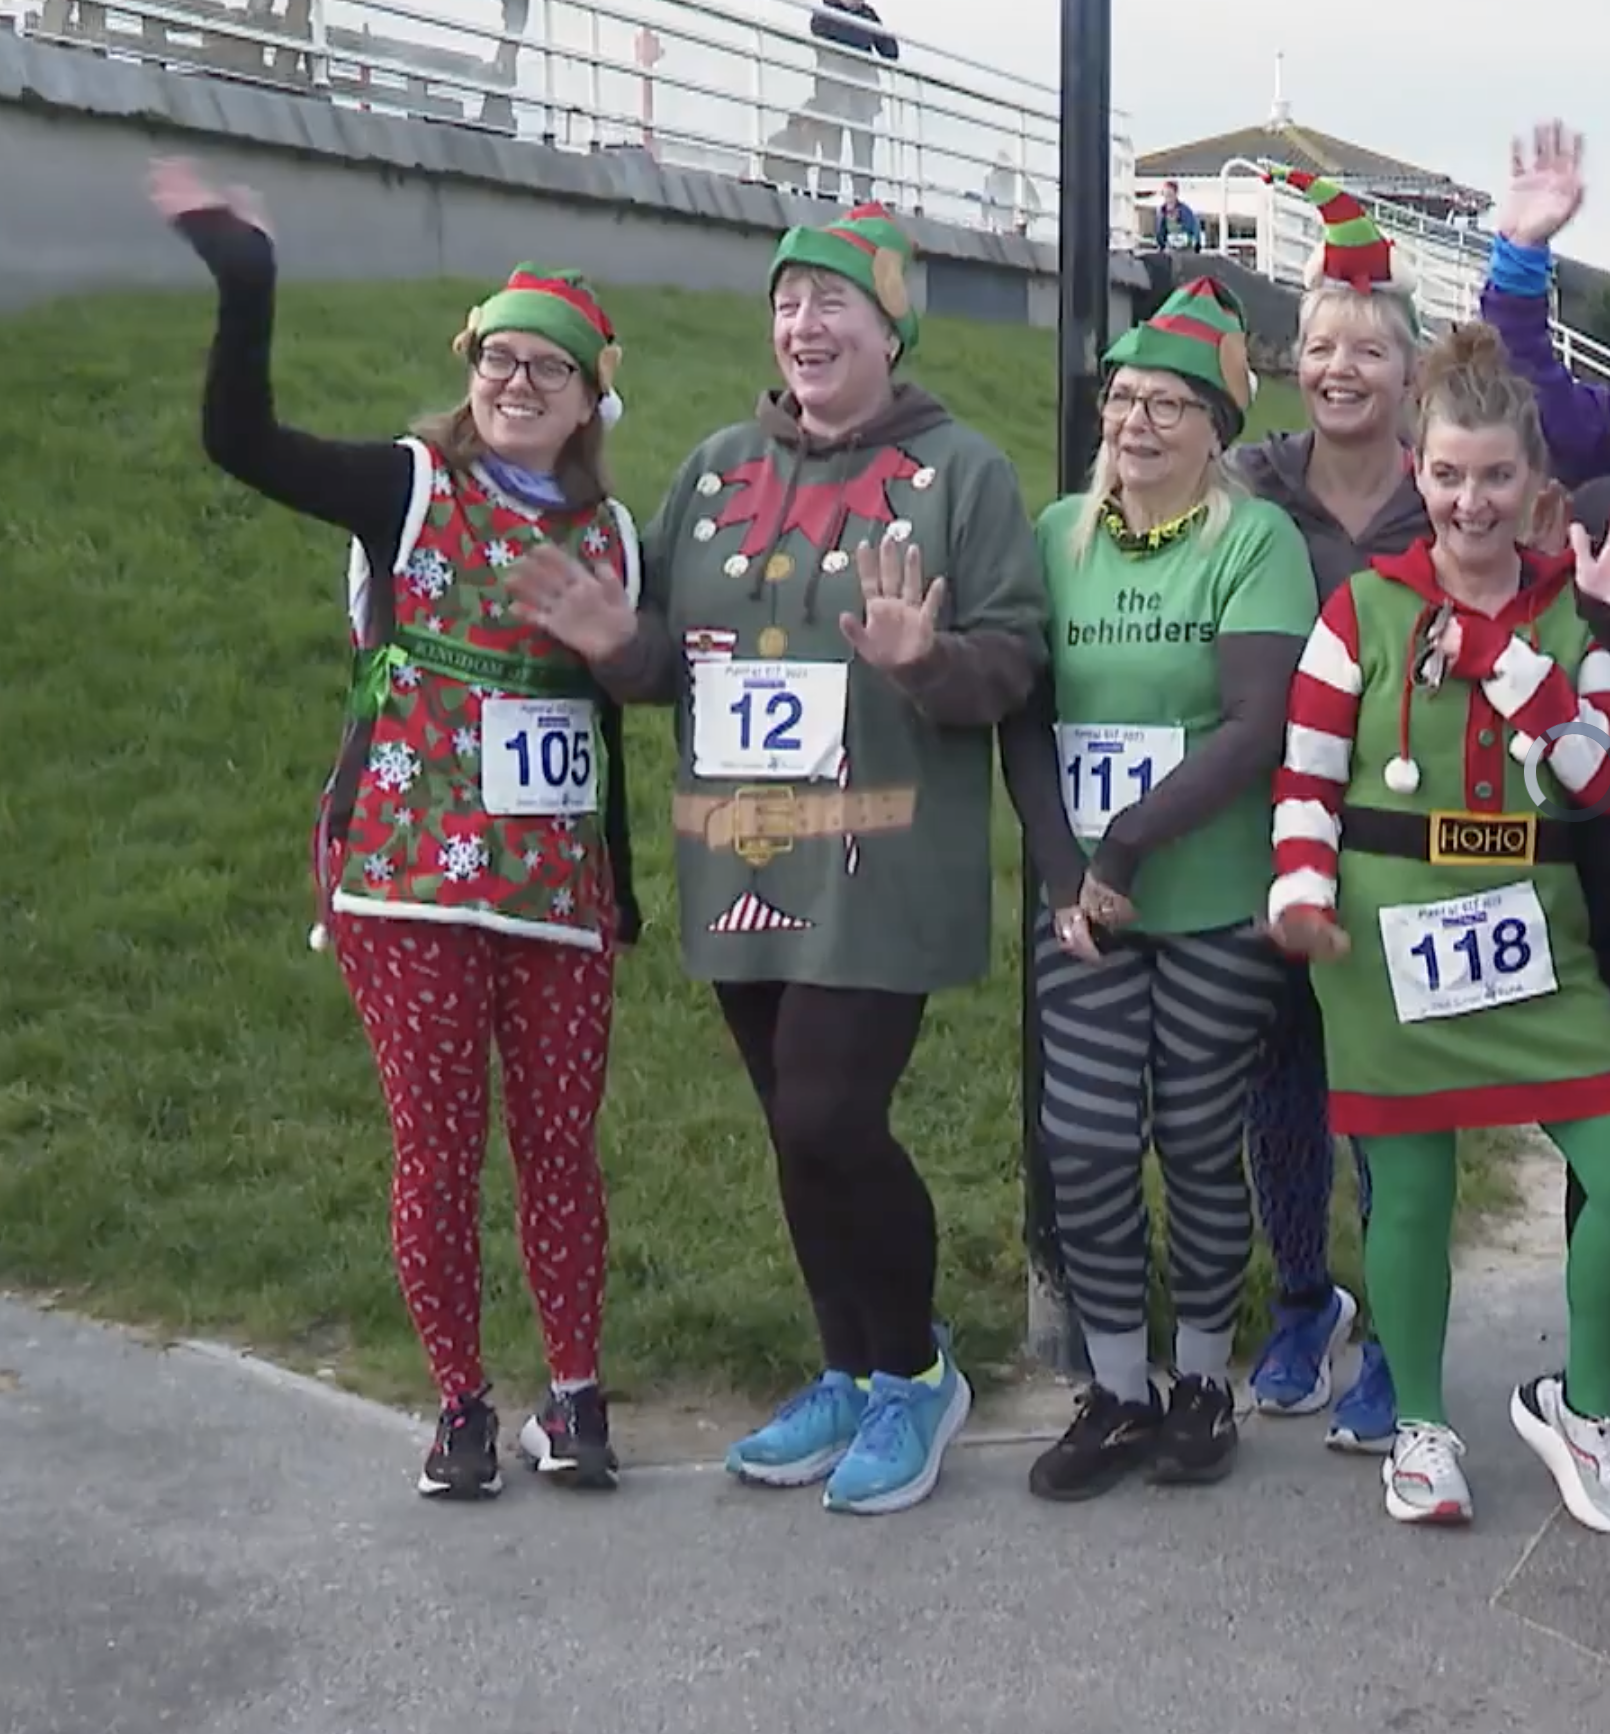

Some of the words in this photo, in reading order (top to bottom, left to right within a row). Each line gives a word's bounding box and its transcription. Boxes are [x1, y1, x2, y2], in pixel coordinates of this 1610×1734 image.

[1117, 588, 1162, 614] the
[1067, 617, 1217, 647] behinders
[730, 691, 804, 751] 12
[504, 730, 591, 788] 105
[1067, 754, 1153, 812] 111
[1441, 822, 1526, 853] HOHO
[1410, 916, 1532, 992] 118
